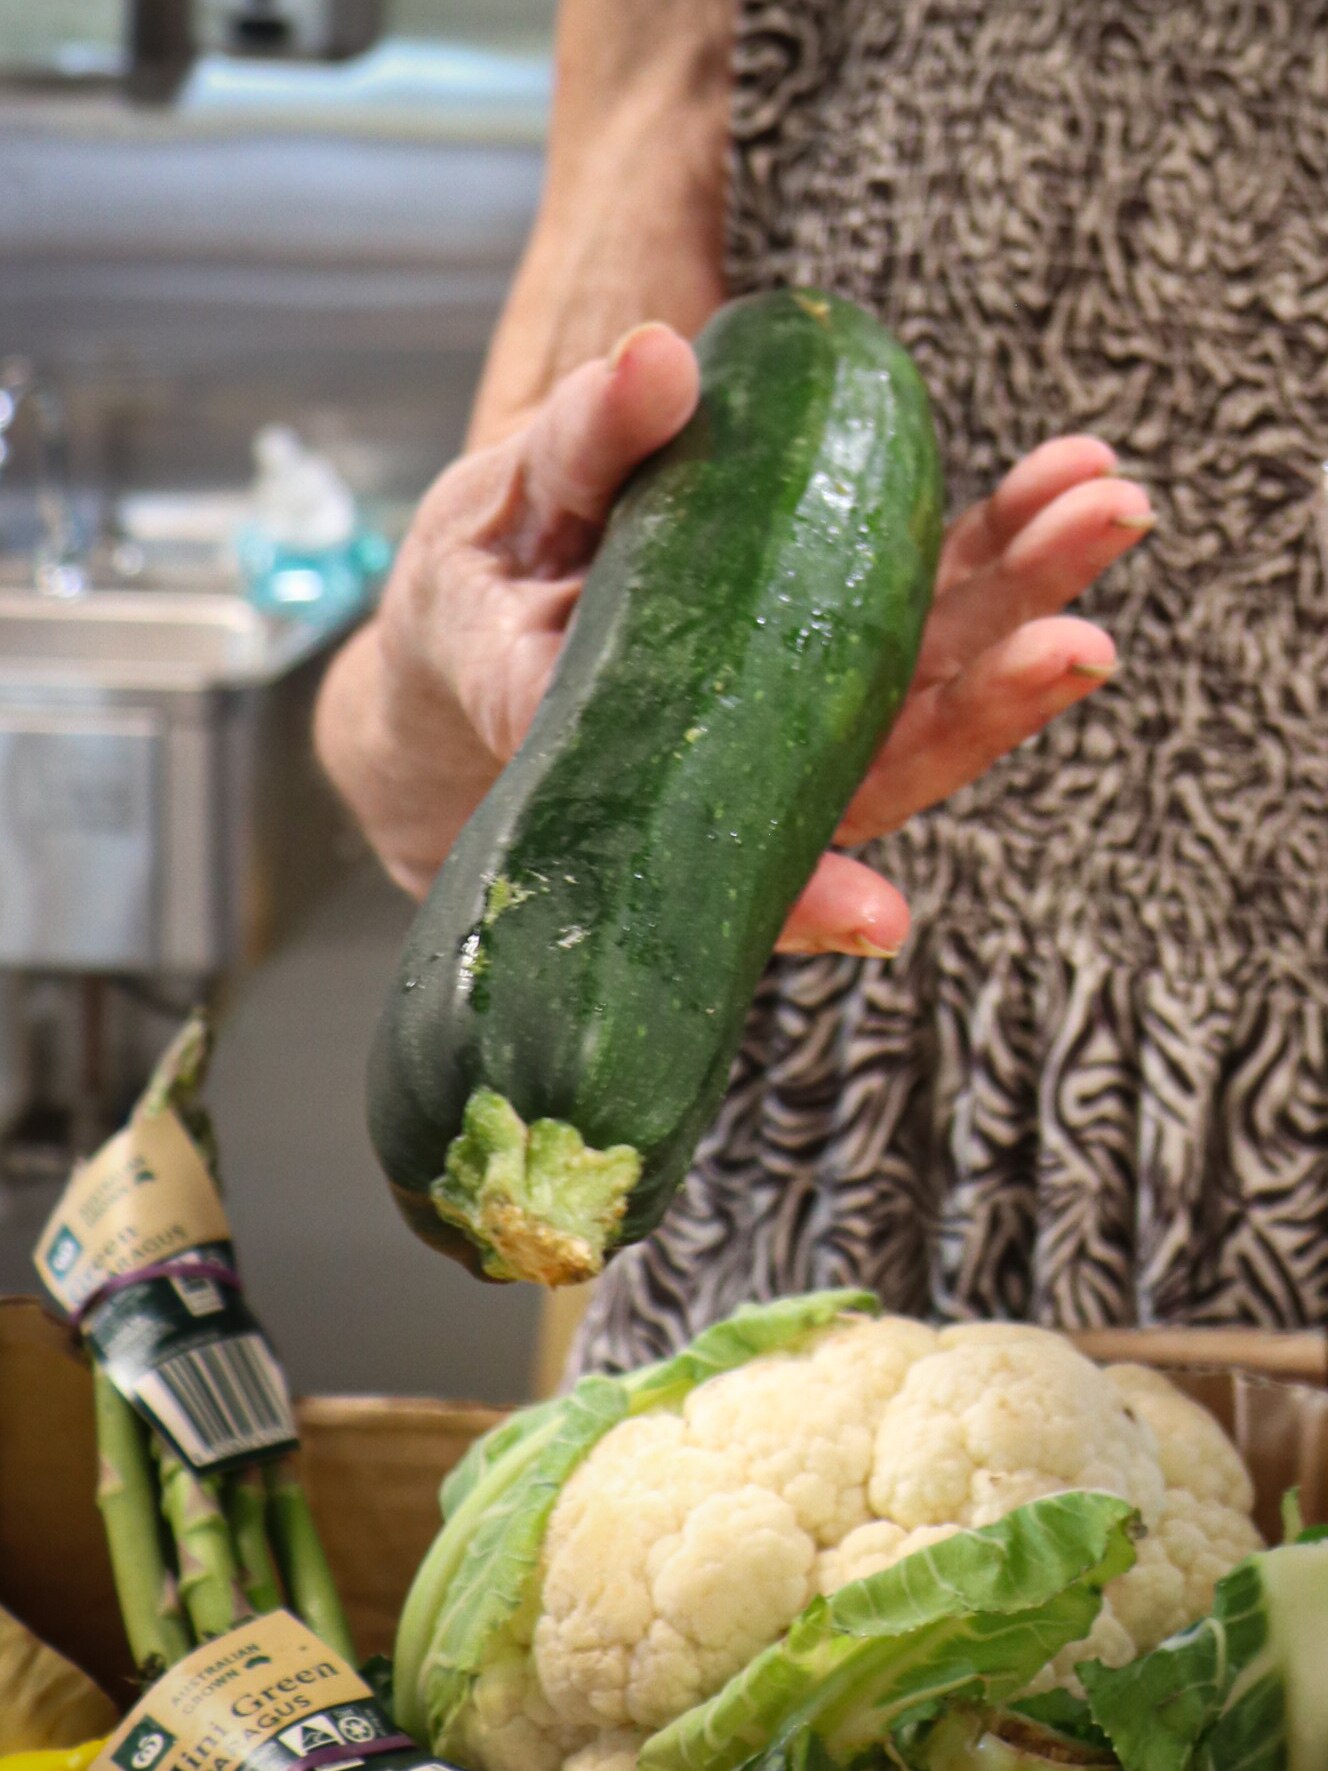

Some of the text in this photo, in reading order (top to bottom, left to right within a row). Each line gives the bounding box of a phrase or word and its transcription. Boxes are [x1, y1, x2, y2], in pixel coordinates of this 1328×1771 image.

[170, 1643, 261, 1707] AUSTRALIAN
[180, 1670, 240, 1716] GROWN
[230, 1662, 339, 1719] Green
